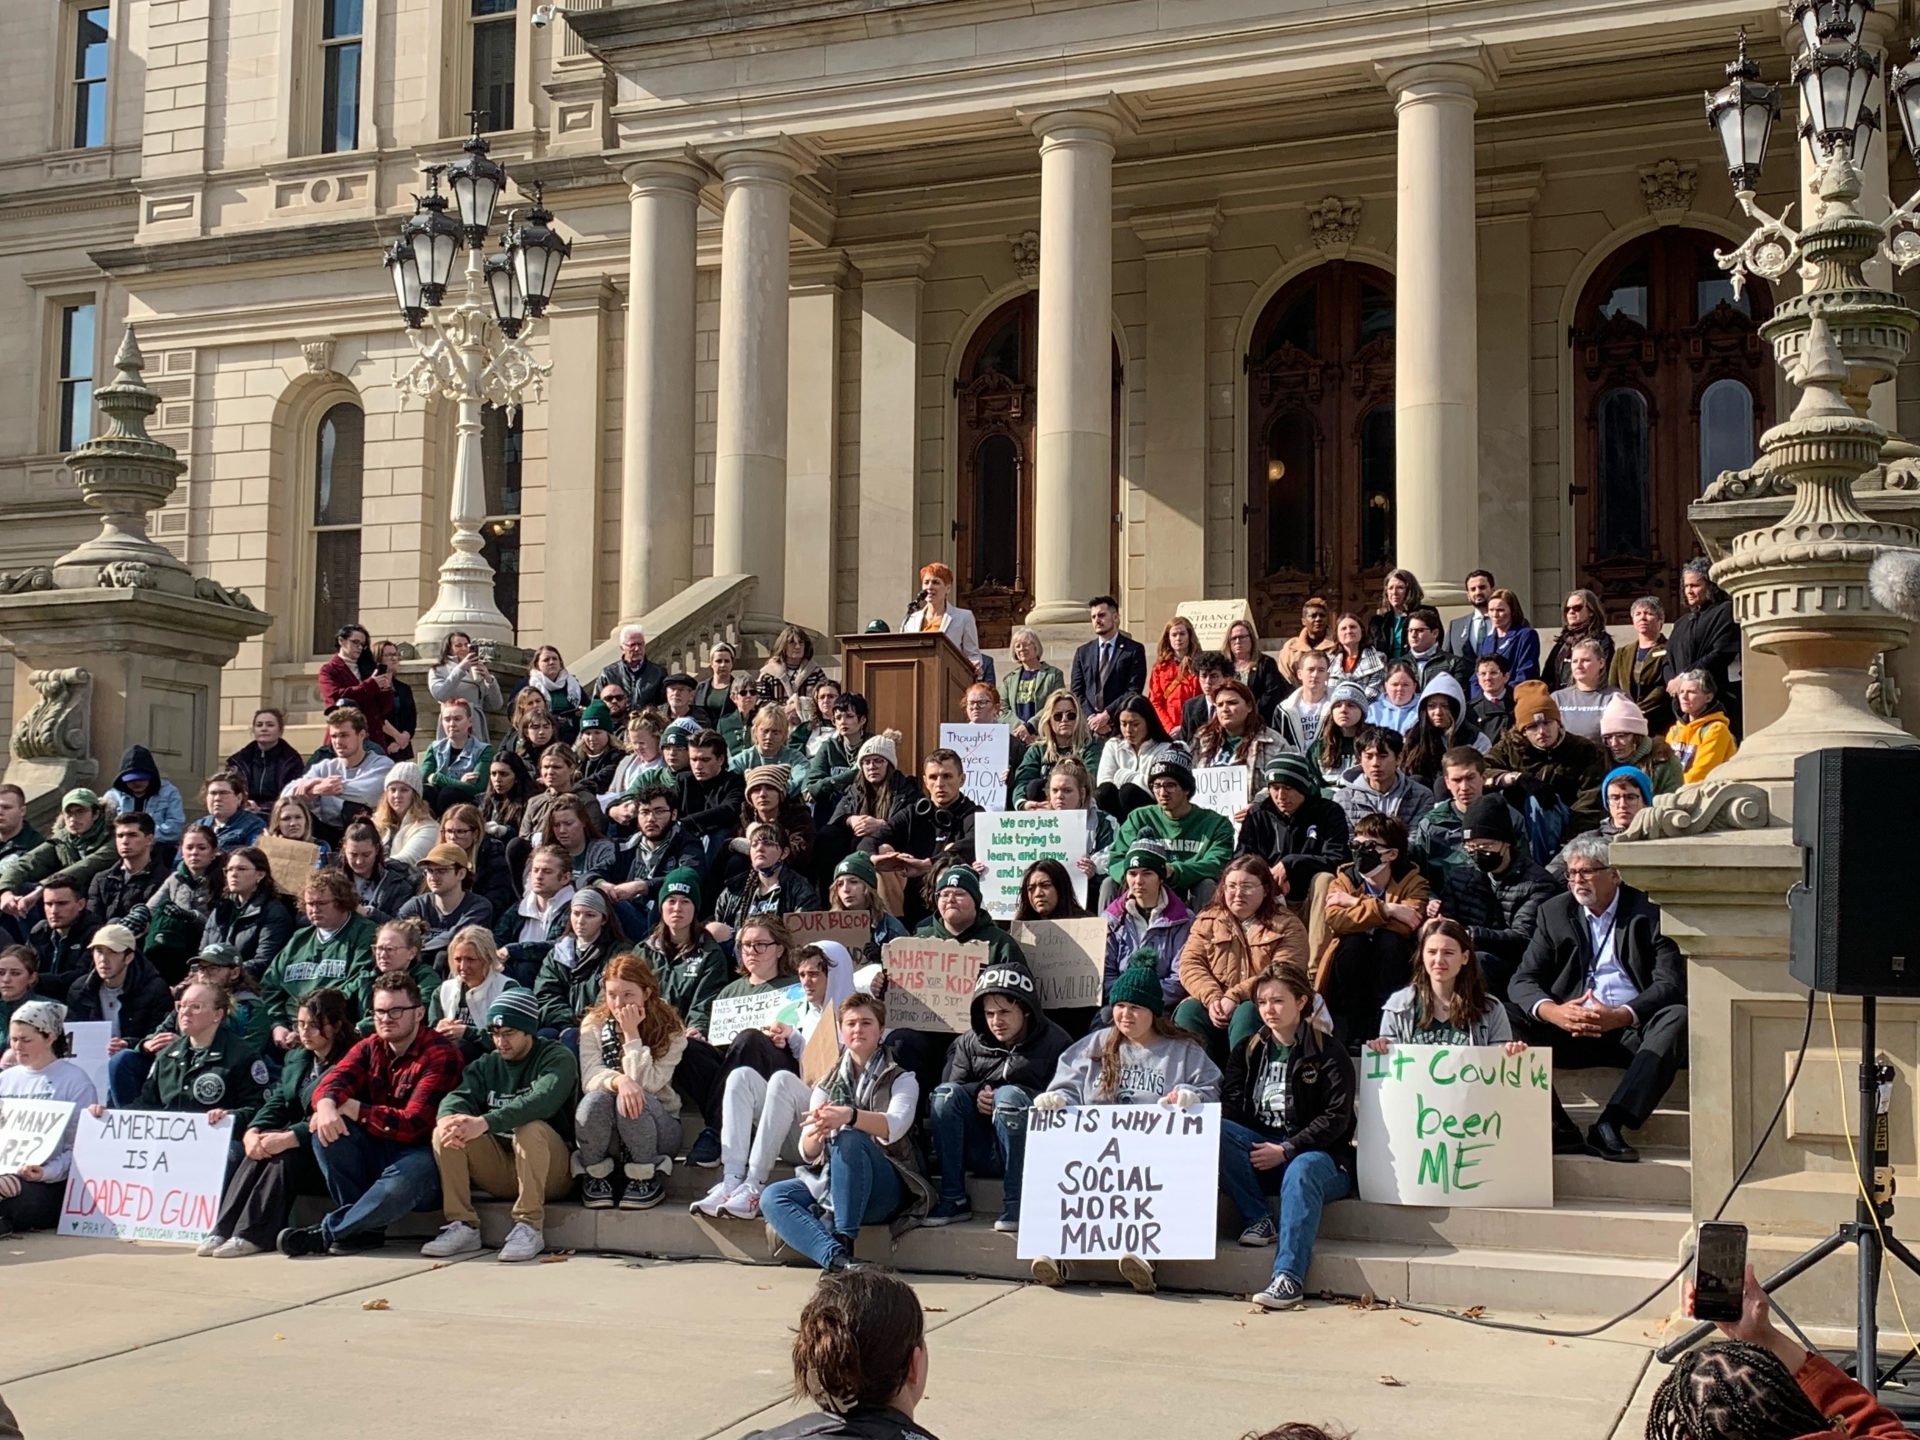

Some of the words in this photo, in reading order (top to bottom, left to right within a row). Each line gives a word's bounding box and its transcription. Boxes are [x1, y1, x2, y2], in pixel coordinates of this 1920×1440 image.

[1194, 622, 1228, 630] LOSED
[947, 731, 993, 747] Thoughts
[961, 757, 990, 768] ayers
[966, 770, 1003, 788] TION
[1195, 770, 1242, 794] NOUGH
[963, 789, 996, 806] OW!
[1209, 795, 1218, 806] IS
[1000, 817, 1015, 828] We
[1018, 819, 1035, 828] are
[1035, 816, 1059, 830] just
[992, 833, 1013, 845] kids
[1015, 833, 1046, 847] trying
[1049, 834, 1061, 844] to
[1018, 849, 1037, 860] and
[997, 866, 1014, 878] and
[785, 913, 825, 933] OUR
[828, 912, 870, 929] BLOOD
[888, 949, 938, 970] WHAT
[941, 953, 959, 972] IF
[963, 955, 983, 978] IT
[887, 971, 925, 989] WAS
[889, 992, 909, 1006] THIS
[11, 1110, 64, 1135] MANY
[1030, 1108, 1067, 1132] THIS
[1075, 1108, 1100, 1132] IS
[1112, 1110, 1162, 1134] WHY
[1416, 1093, 1502, 1139] been
[100, 1114, 198, 1141] AMERICA
[1097, 1137, 1120, 1163] A
[123, 1150, 148, 1169] IS
[153, 1151, 168, 1172] A
[1417, 1141, 1497, 1194] ME
[1057, 1160, 1163, 1195] SOCIAL
[65, 1178, 153, 1221] LOADED
[160, 1190, 217, 1229] GUN
[1061, 1195, 1154, 1220] WORK
[82, 1221, 105, 1234] PRAY
[112, 1224, 126, 1235] FOR
[134, 1226, 174, 1239] MICHIGAN
[177, 1230, 199, 1240] STATE
[1061, 1222, 1161, 1255] MAJOR
